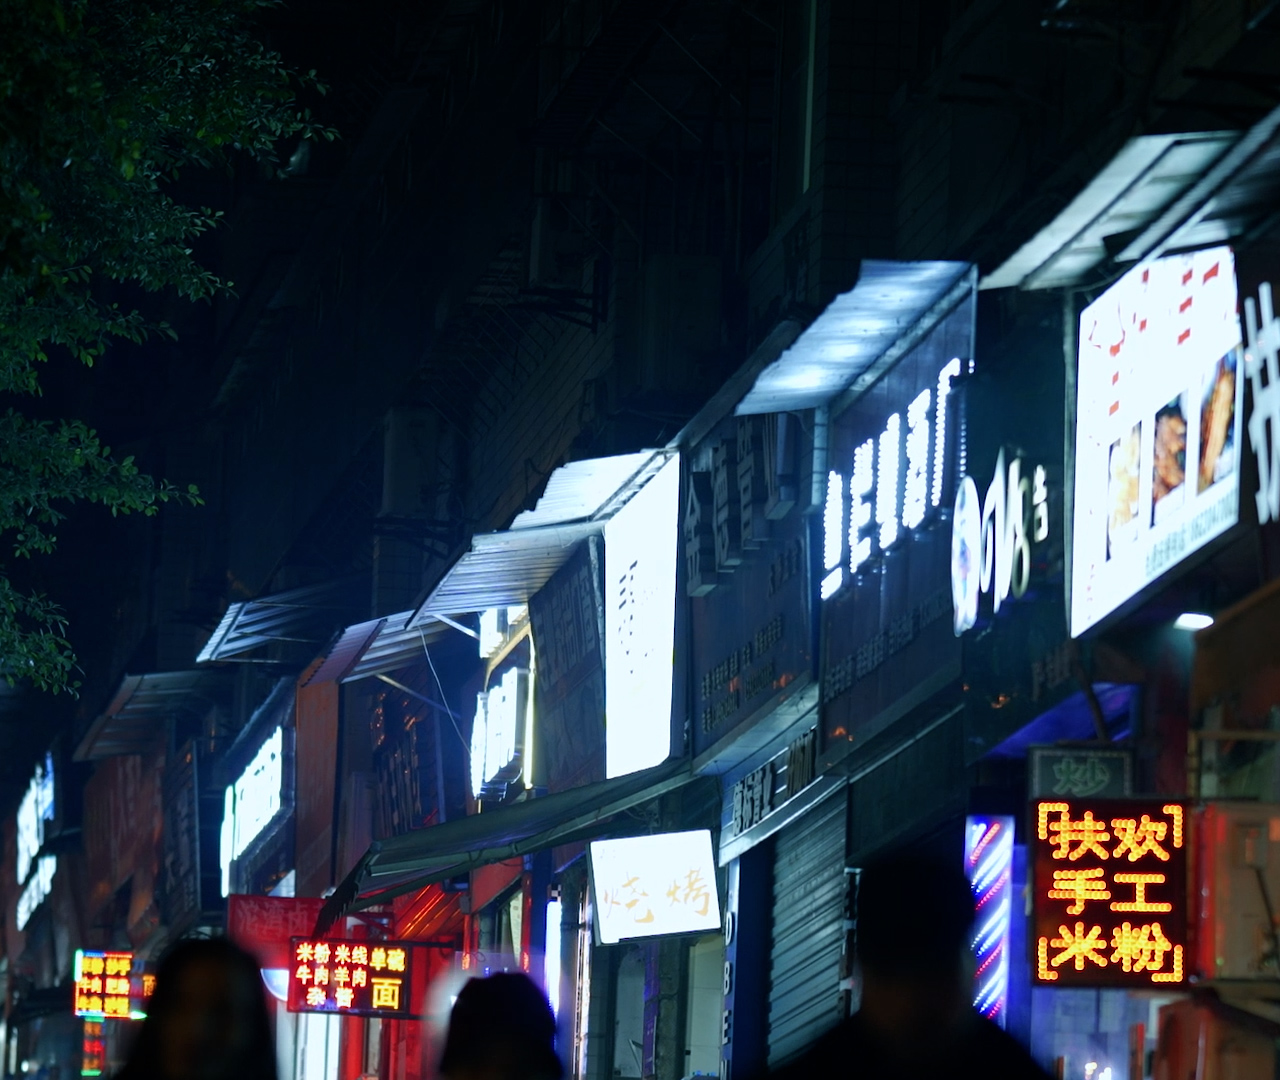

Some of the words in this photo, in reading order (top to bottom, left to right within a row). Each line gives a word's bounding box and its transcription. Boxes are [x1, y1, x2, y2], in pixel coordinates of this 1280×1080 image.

[1049, 811, 1170, 862] 扶欢
[604, 867, 710, 923] 烧烤
[1048, 868, 1172, 915] 手工
[296, 942, 331, 964] 米粉
[335, 944, 368, 966] 米线
[1050, 922, 1172, 972] 米粉
[296, 965, 330, 986] 牛肉
[334, 966, 367, 988] 羊肉
[371, 977, 402, 1010] 面
